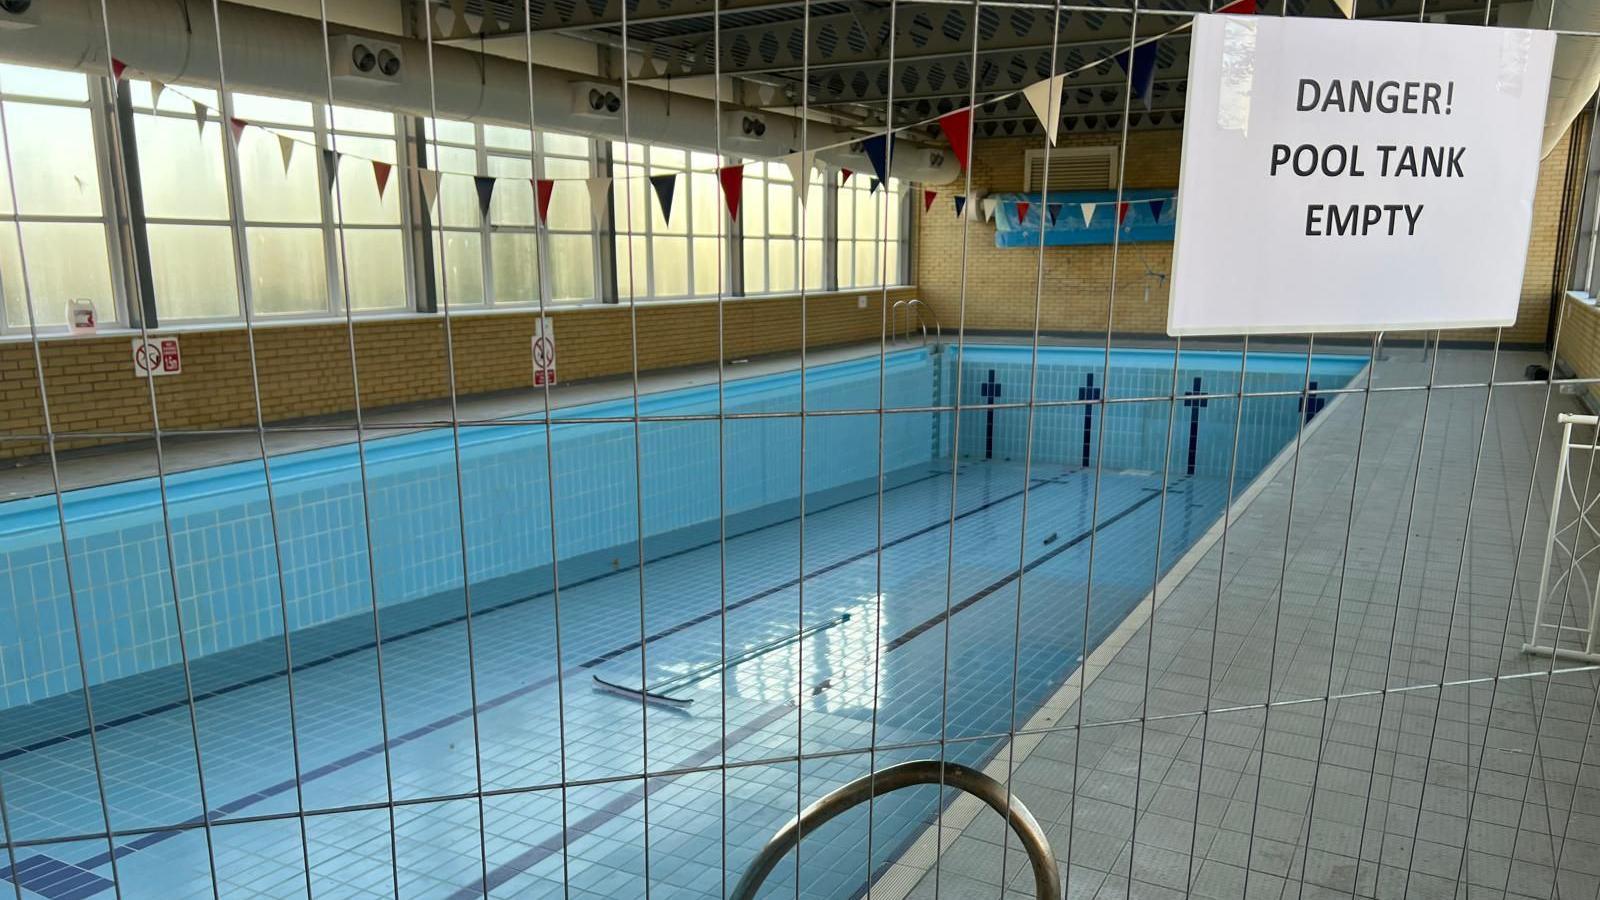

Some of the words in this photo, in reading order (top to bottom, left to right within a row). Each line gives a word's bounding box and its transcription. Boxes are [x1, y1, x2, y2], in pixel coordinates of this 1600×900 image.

[1296, 78, 1454, 115] DANGER!
[1270, 143, 1365, 178] POOL
[1376, 145, 1466, 178] TANK
[1305, 203, 1424, 237] EMPTY
